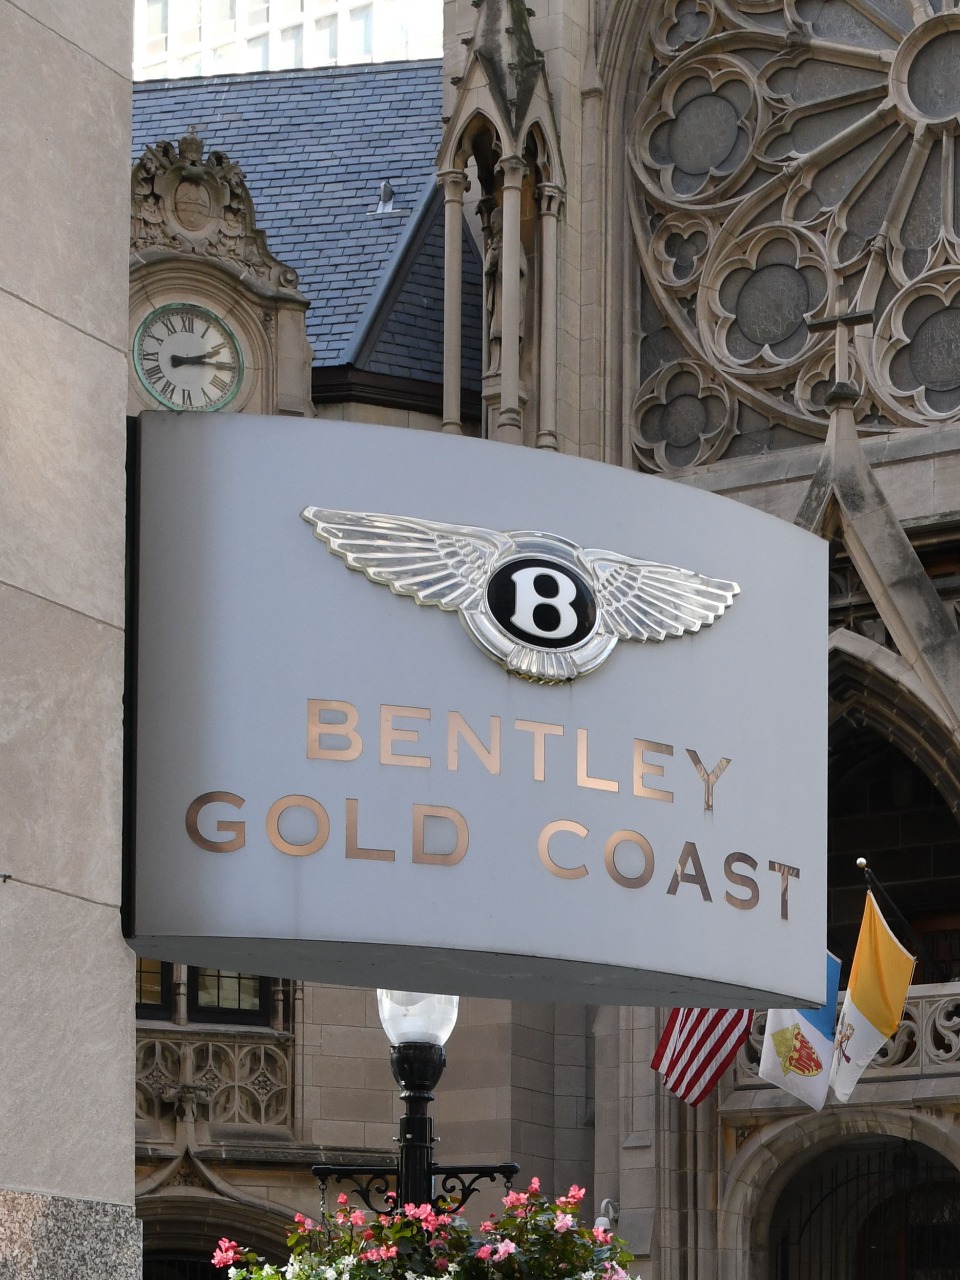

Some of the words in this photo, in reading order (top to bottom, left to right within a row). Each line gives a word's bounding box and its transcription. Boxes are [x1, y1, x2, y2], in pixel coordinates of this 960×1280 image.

[305, 697, 732, 812] BENTLEY
[184, 790, 470, 867] GOLD
[536, 819, 800, 921] COAST
